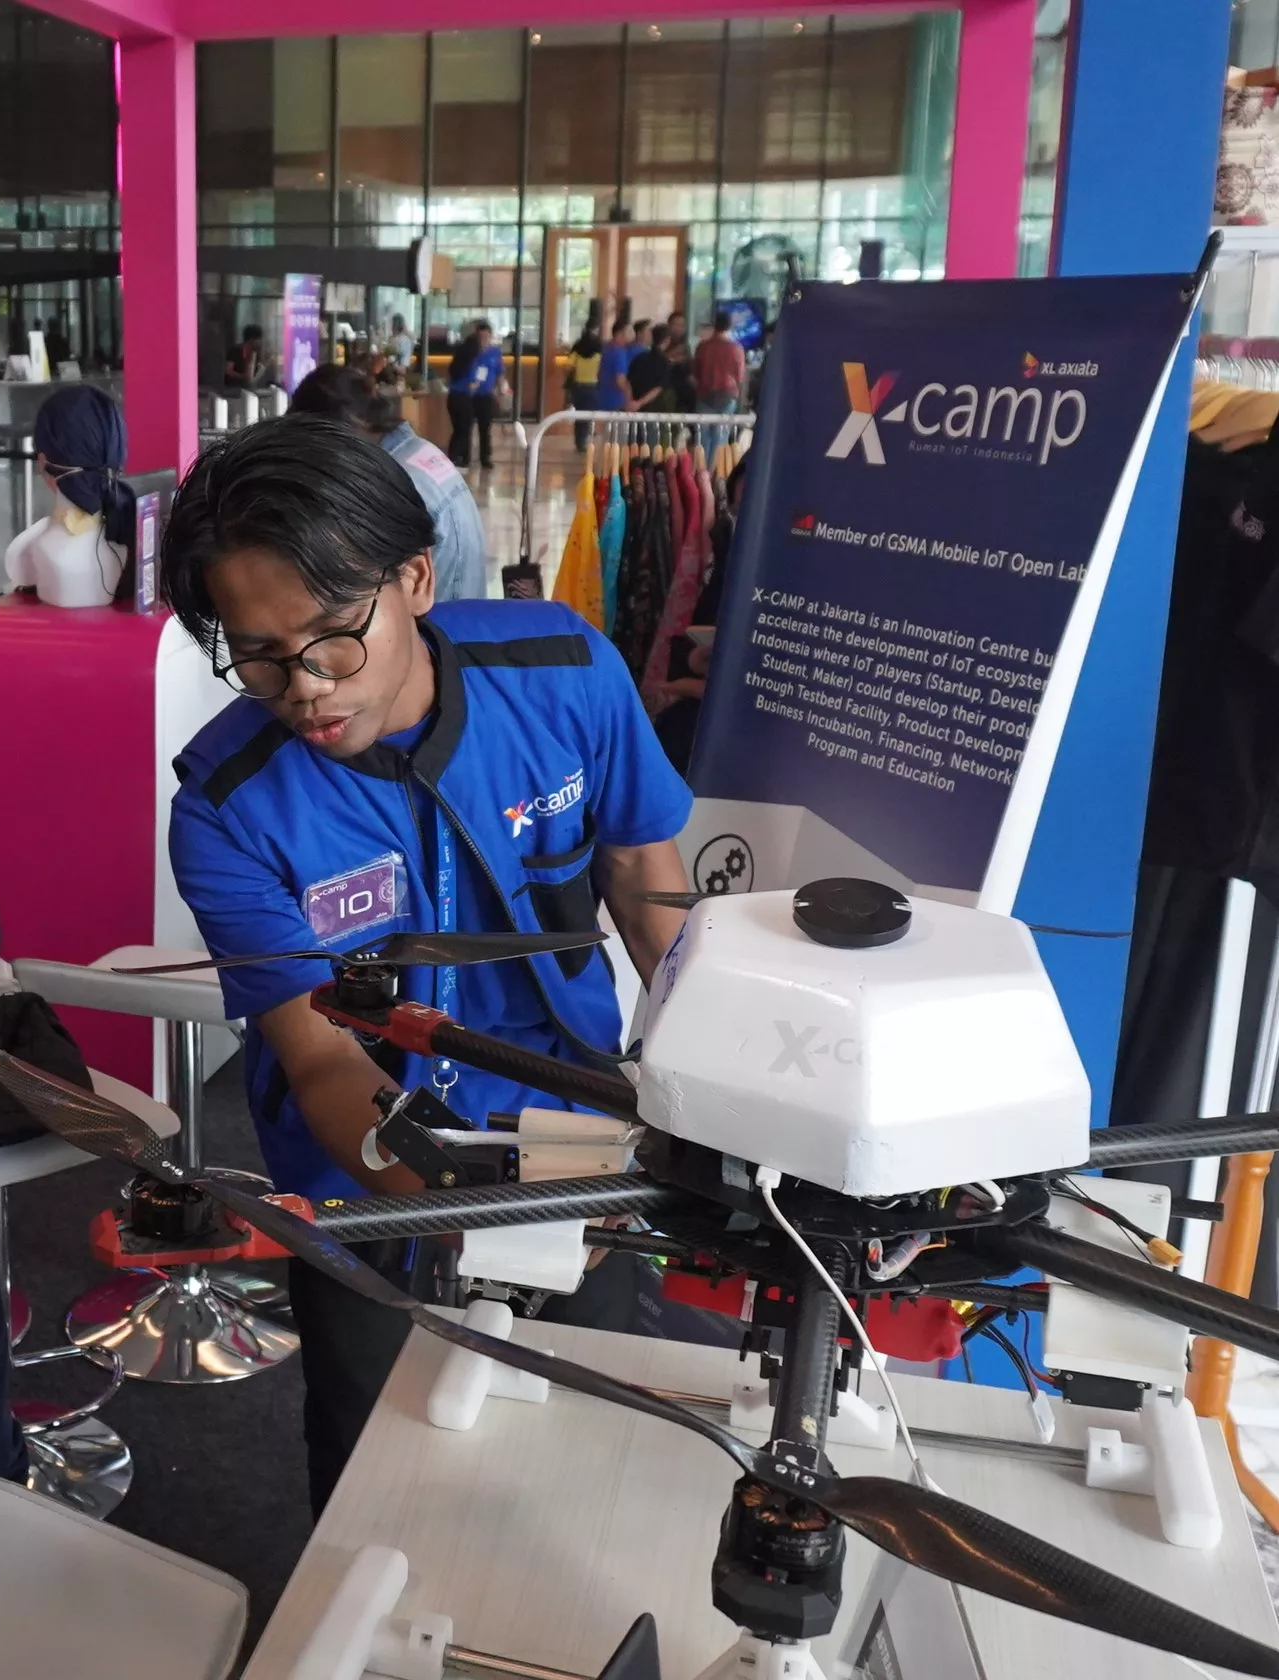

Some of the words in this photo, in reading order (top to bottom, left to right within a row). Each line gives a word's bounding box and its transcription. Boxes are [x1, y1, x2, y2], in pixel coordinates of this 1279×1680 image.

[1041, 362, 1056, 375] XL
[1058, 360, 1099, 376] axiata
[909, 440, 946, 454] Rumah
[815, 522, 867, 545] Member
[870, 532, 886, 548] of
[888, 533, 927, 556] GSMA
[931, 540, 980, 564] Mobile
[983, 549, 1008, 568] IoT
[1011, 553, 1054, 577] Open
[752, 587, 805, 610] X-CAMP
[807, 601, 819, 614] at
[822, 602, 866, 625] Jakarta
[870, 612, 880, 628] is
[883, 618, 899, 632] an
[902, 619, 975, 650] Innovation
[980, 636, 1029, 662] Centre
[758, 612, 820, 637] accelerate
[823, 626, 843, 642] the
[846, 631, 929, 664] development
[933, 652, 948, 667] of
[951, 654, 974, 674] IoT
[751, 629, 810, 657] Indonesia
[813, 647, 850, 667] where
[853, 654, 874, 672] IoT
[875, 662, 922, 686] players
[926, 672, 984, 704] (Startup,
[762, 653, 809, 680] Student,
[812, 667, 853, 692] Maker)
[856, 681, 892, 701] could
[895, 689, 948, 719] develop
[952, 705, 987, 727] their
[745, 671, 794, 697] through
[798, 684, 843, 710] Testbed
[845, 698, 892, 727] Facility,
[897, 712, 951, 742] Product
[756, 694, 804, 721] Business
[807, 710, 873, 744] Incubation,
[878, 731, 945, 767] Financing,
[807, 732, 858, 761] Program
[861, 752, 885, 769] and
[888, 757, 956, 792] Education
